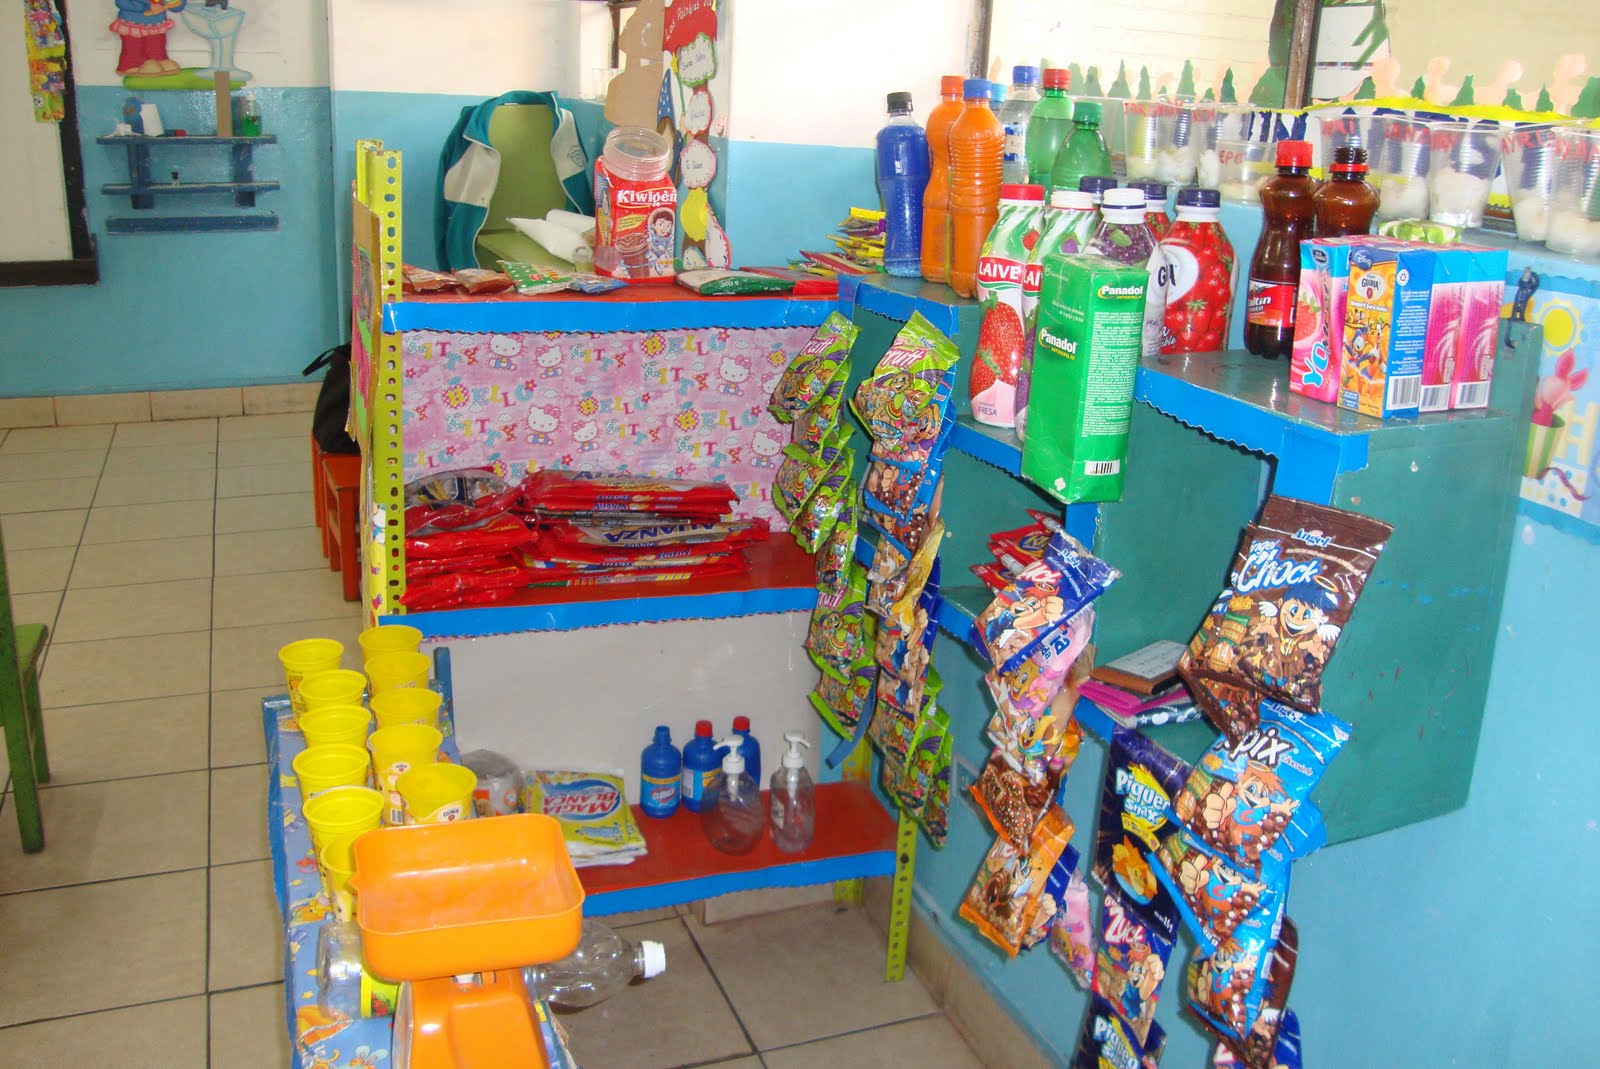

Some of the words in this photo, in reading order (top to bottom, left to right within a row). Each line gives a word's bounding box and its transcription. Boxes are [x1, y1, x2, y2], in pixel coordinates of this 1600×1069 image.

[979, 262, 1020, 280] LAIVE
[1023, 271, 1041, 286] LAI
[1101, 286, 1144, 295] Panadol
[1041, 328, 1078, 354] Panadol
[978, 407, 998, 416] FRESA
[1249, 539, 1281, 555] ngel
[1291, 528, 1332, 548] Angel
[1237, 549, 1320, 592] Chock
[1125, 797, 1161, 827] Snax
